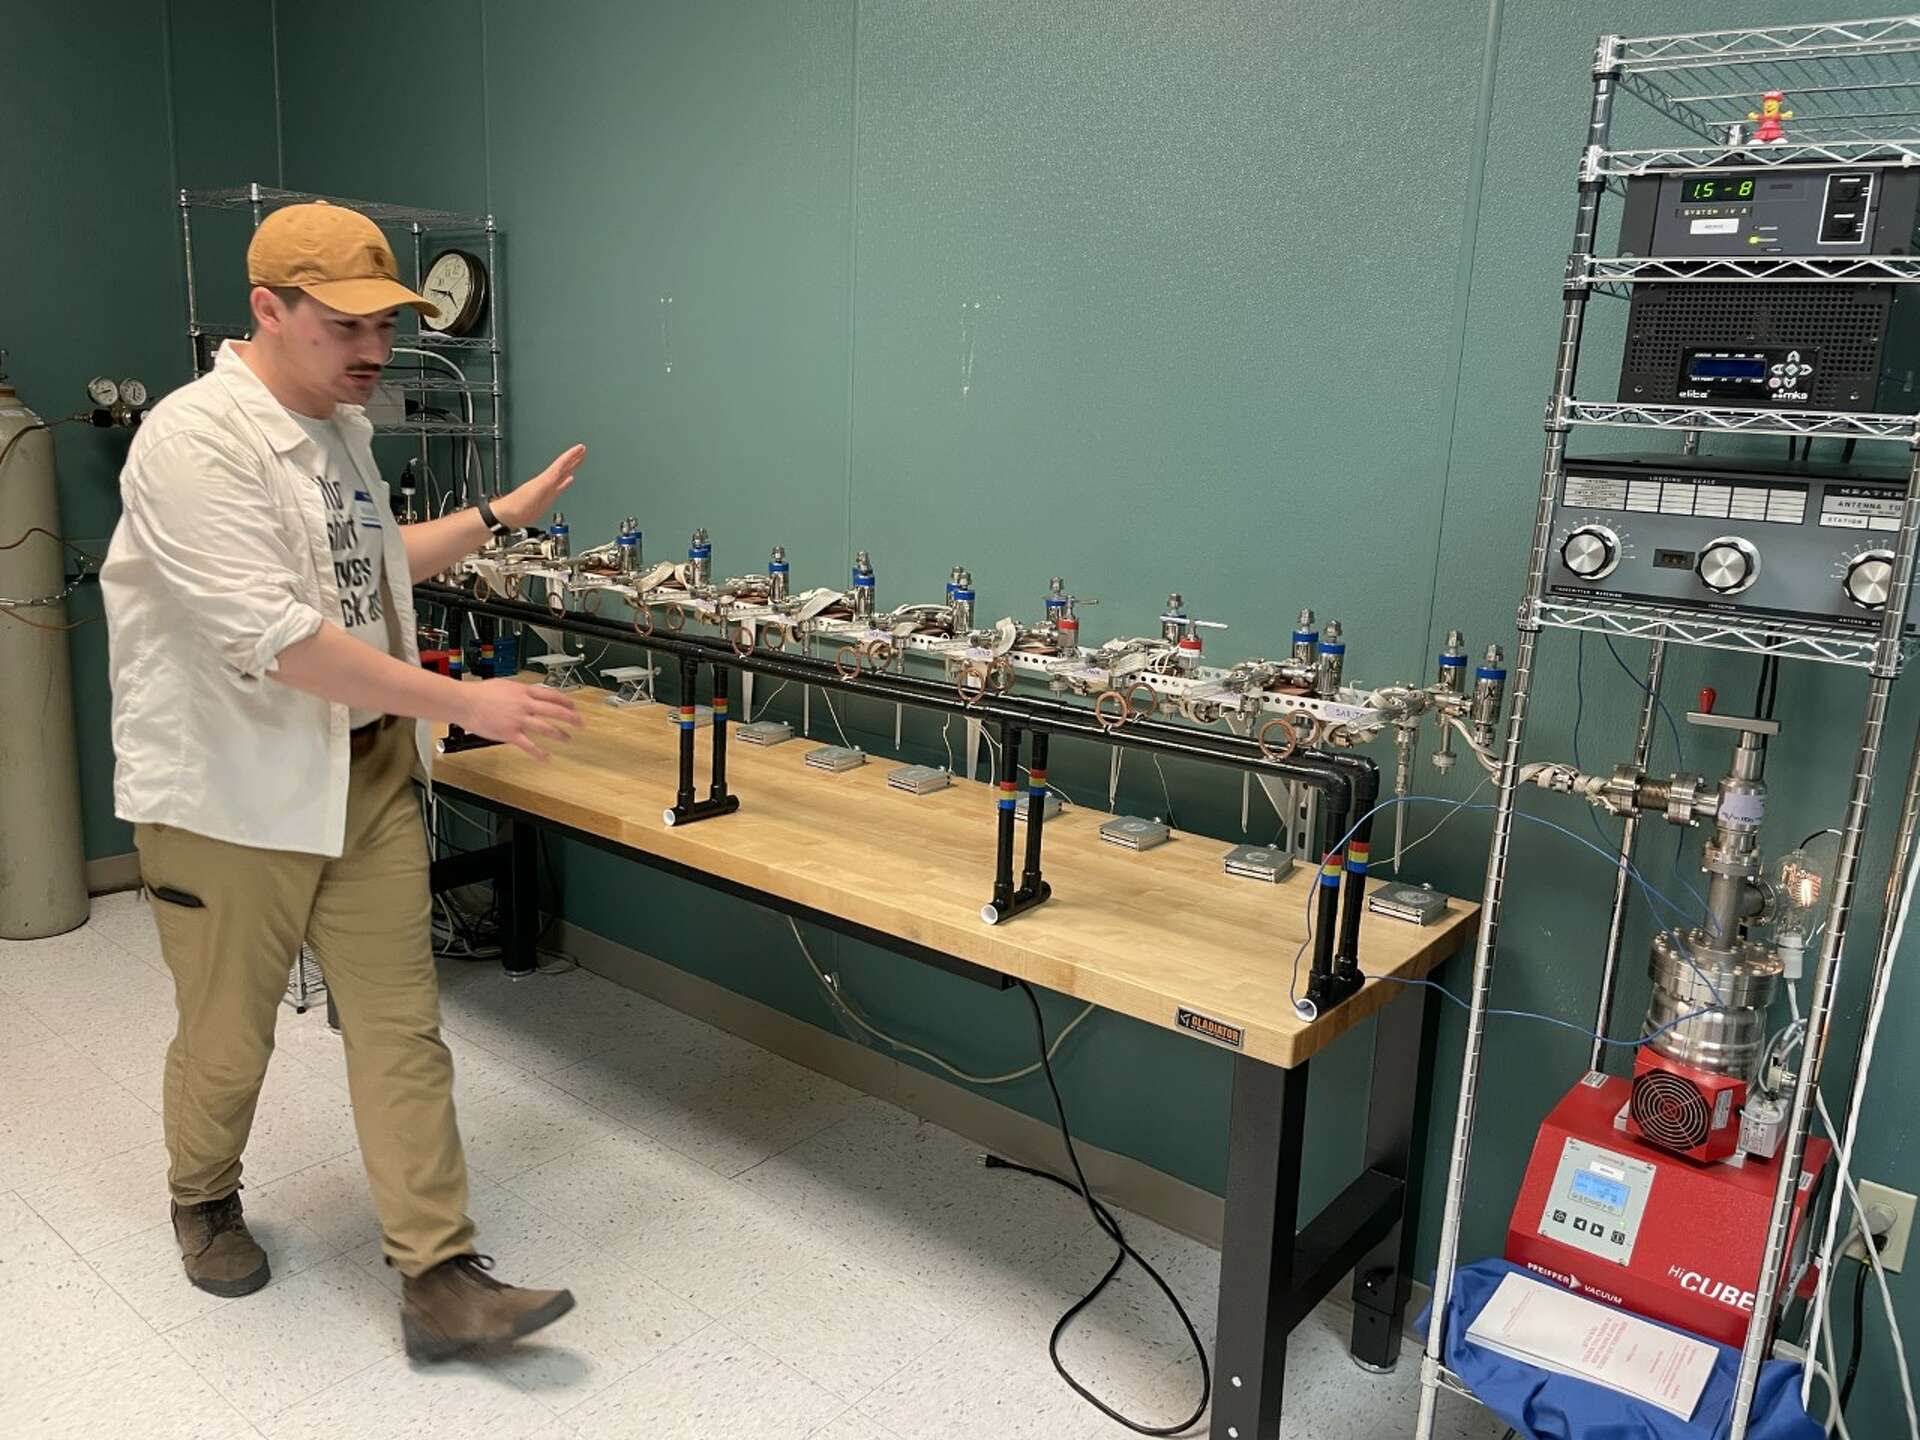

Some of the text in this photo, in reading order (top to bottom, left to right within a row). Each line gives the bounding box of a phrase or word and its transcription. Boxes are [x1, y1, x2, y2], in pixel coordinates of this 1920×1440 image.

[1738, 181, 1753, 196] 8
[1840, 488, 1904, 498] HEATHK
[1837, 501, 1883, 510] ANTENNA
[1191, 1015, 1239, 1042] GLADIATOR
[1527, 1262, 1623, 1305] PFEIFFER VACUUM
